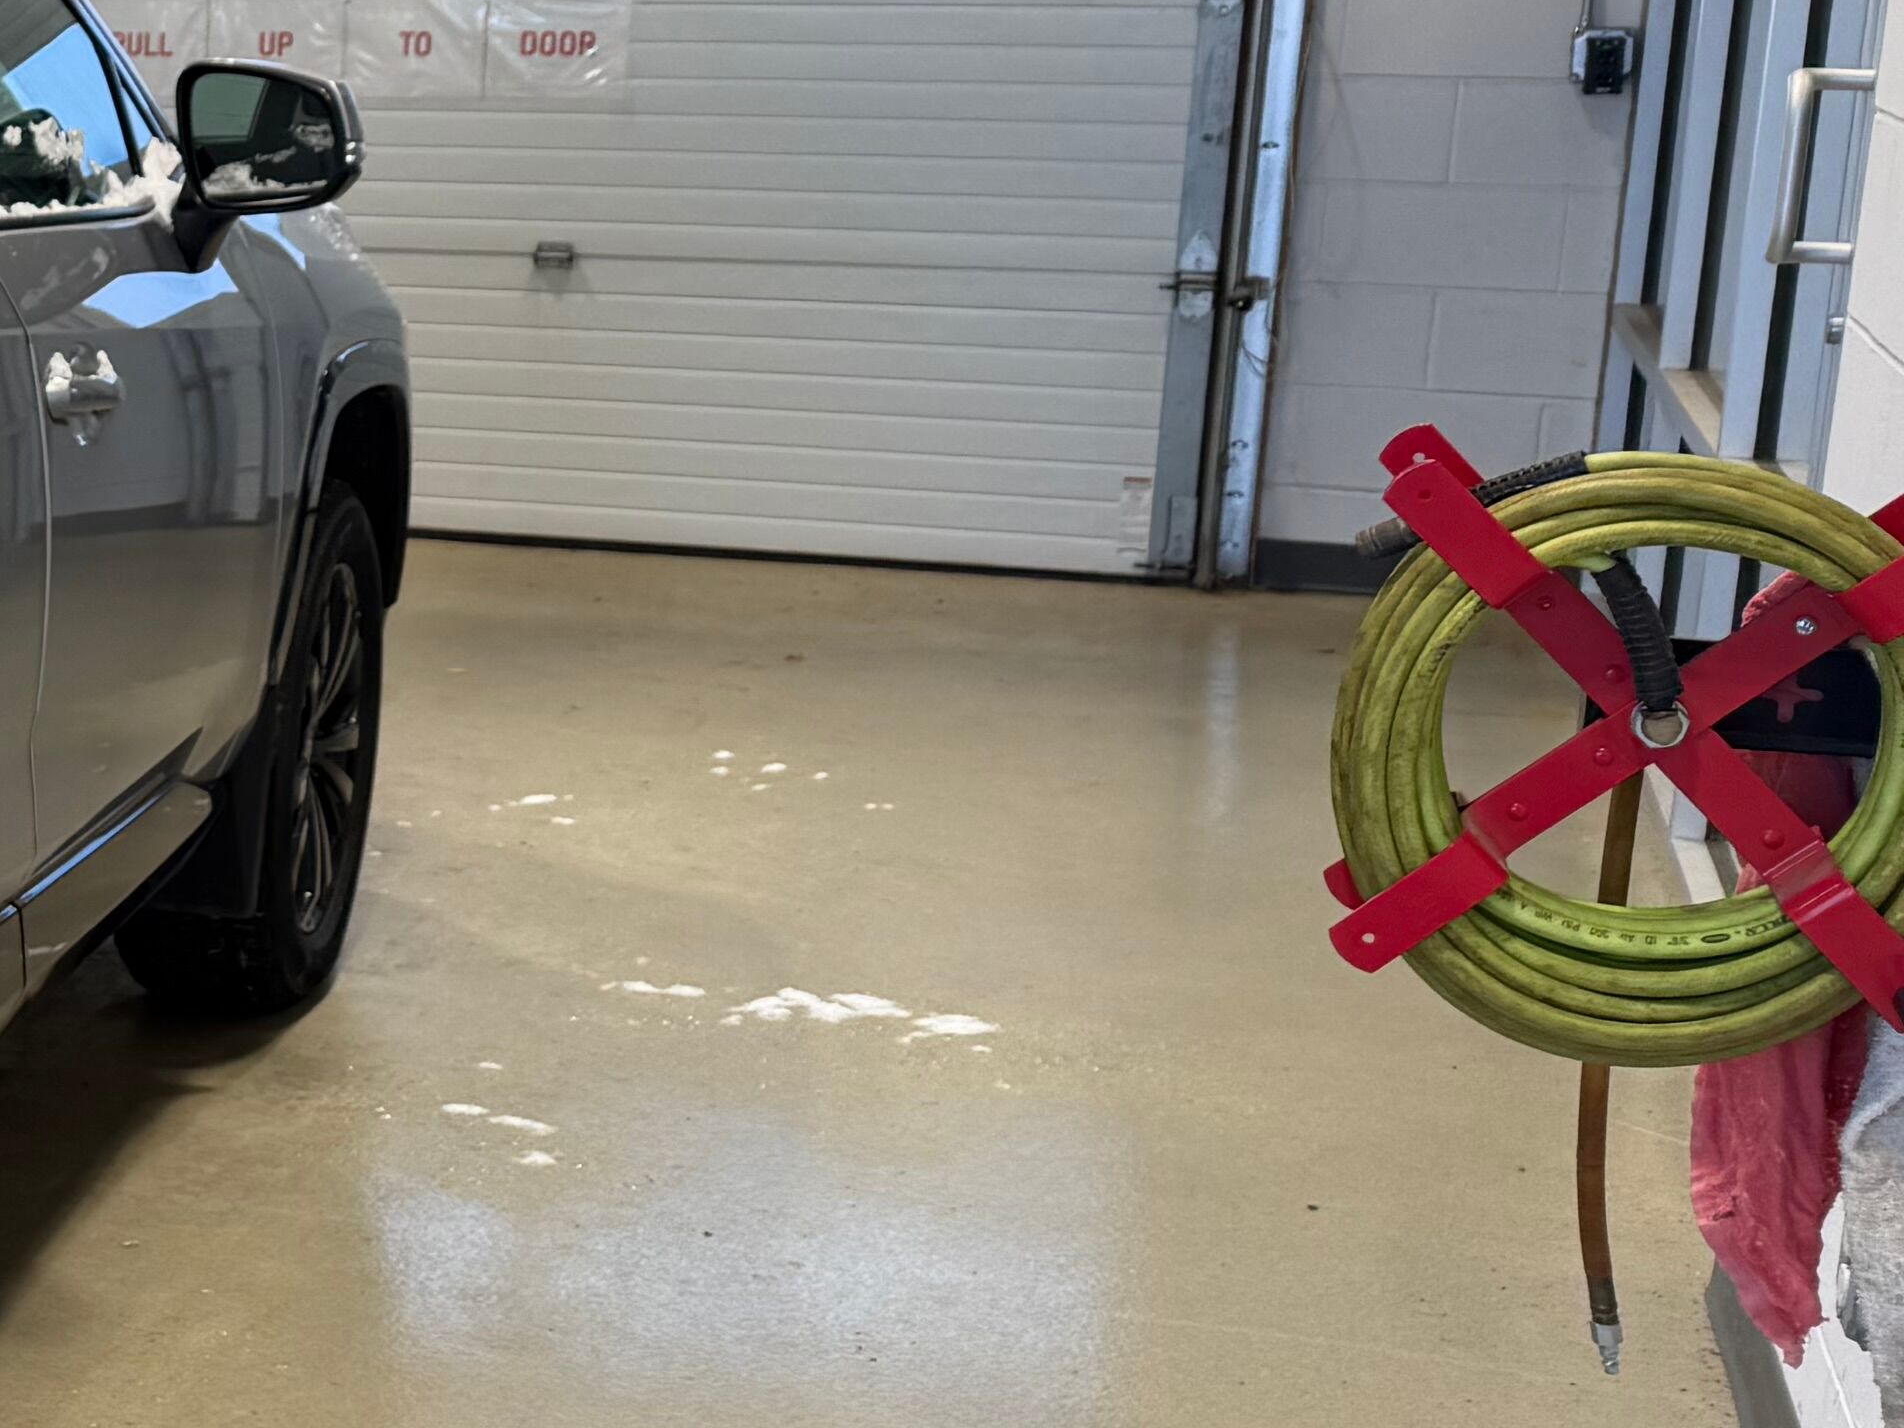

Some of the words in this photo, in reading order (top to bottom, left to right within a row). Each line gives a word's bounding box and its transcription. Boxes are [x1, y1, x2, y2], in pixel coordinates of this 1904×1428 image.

[258, 30, 293, 57] UP
[399, 30, 432, 57] TO
[1561, 919, 1581, 932] PSI
[1645, 934, 1658, 946] ID
